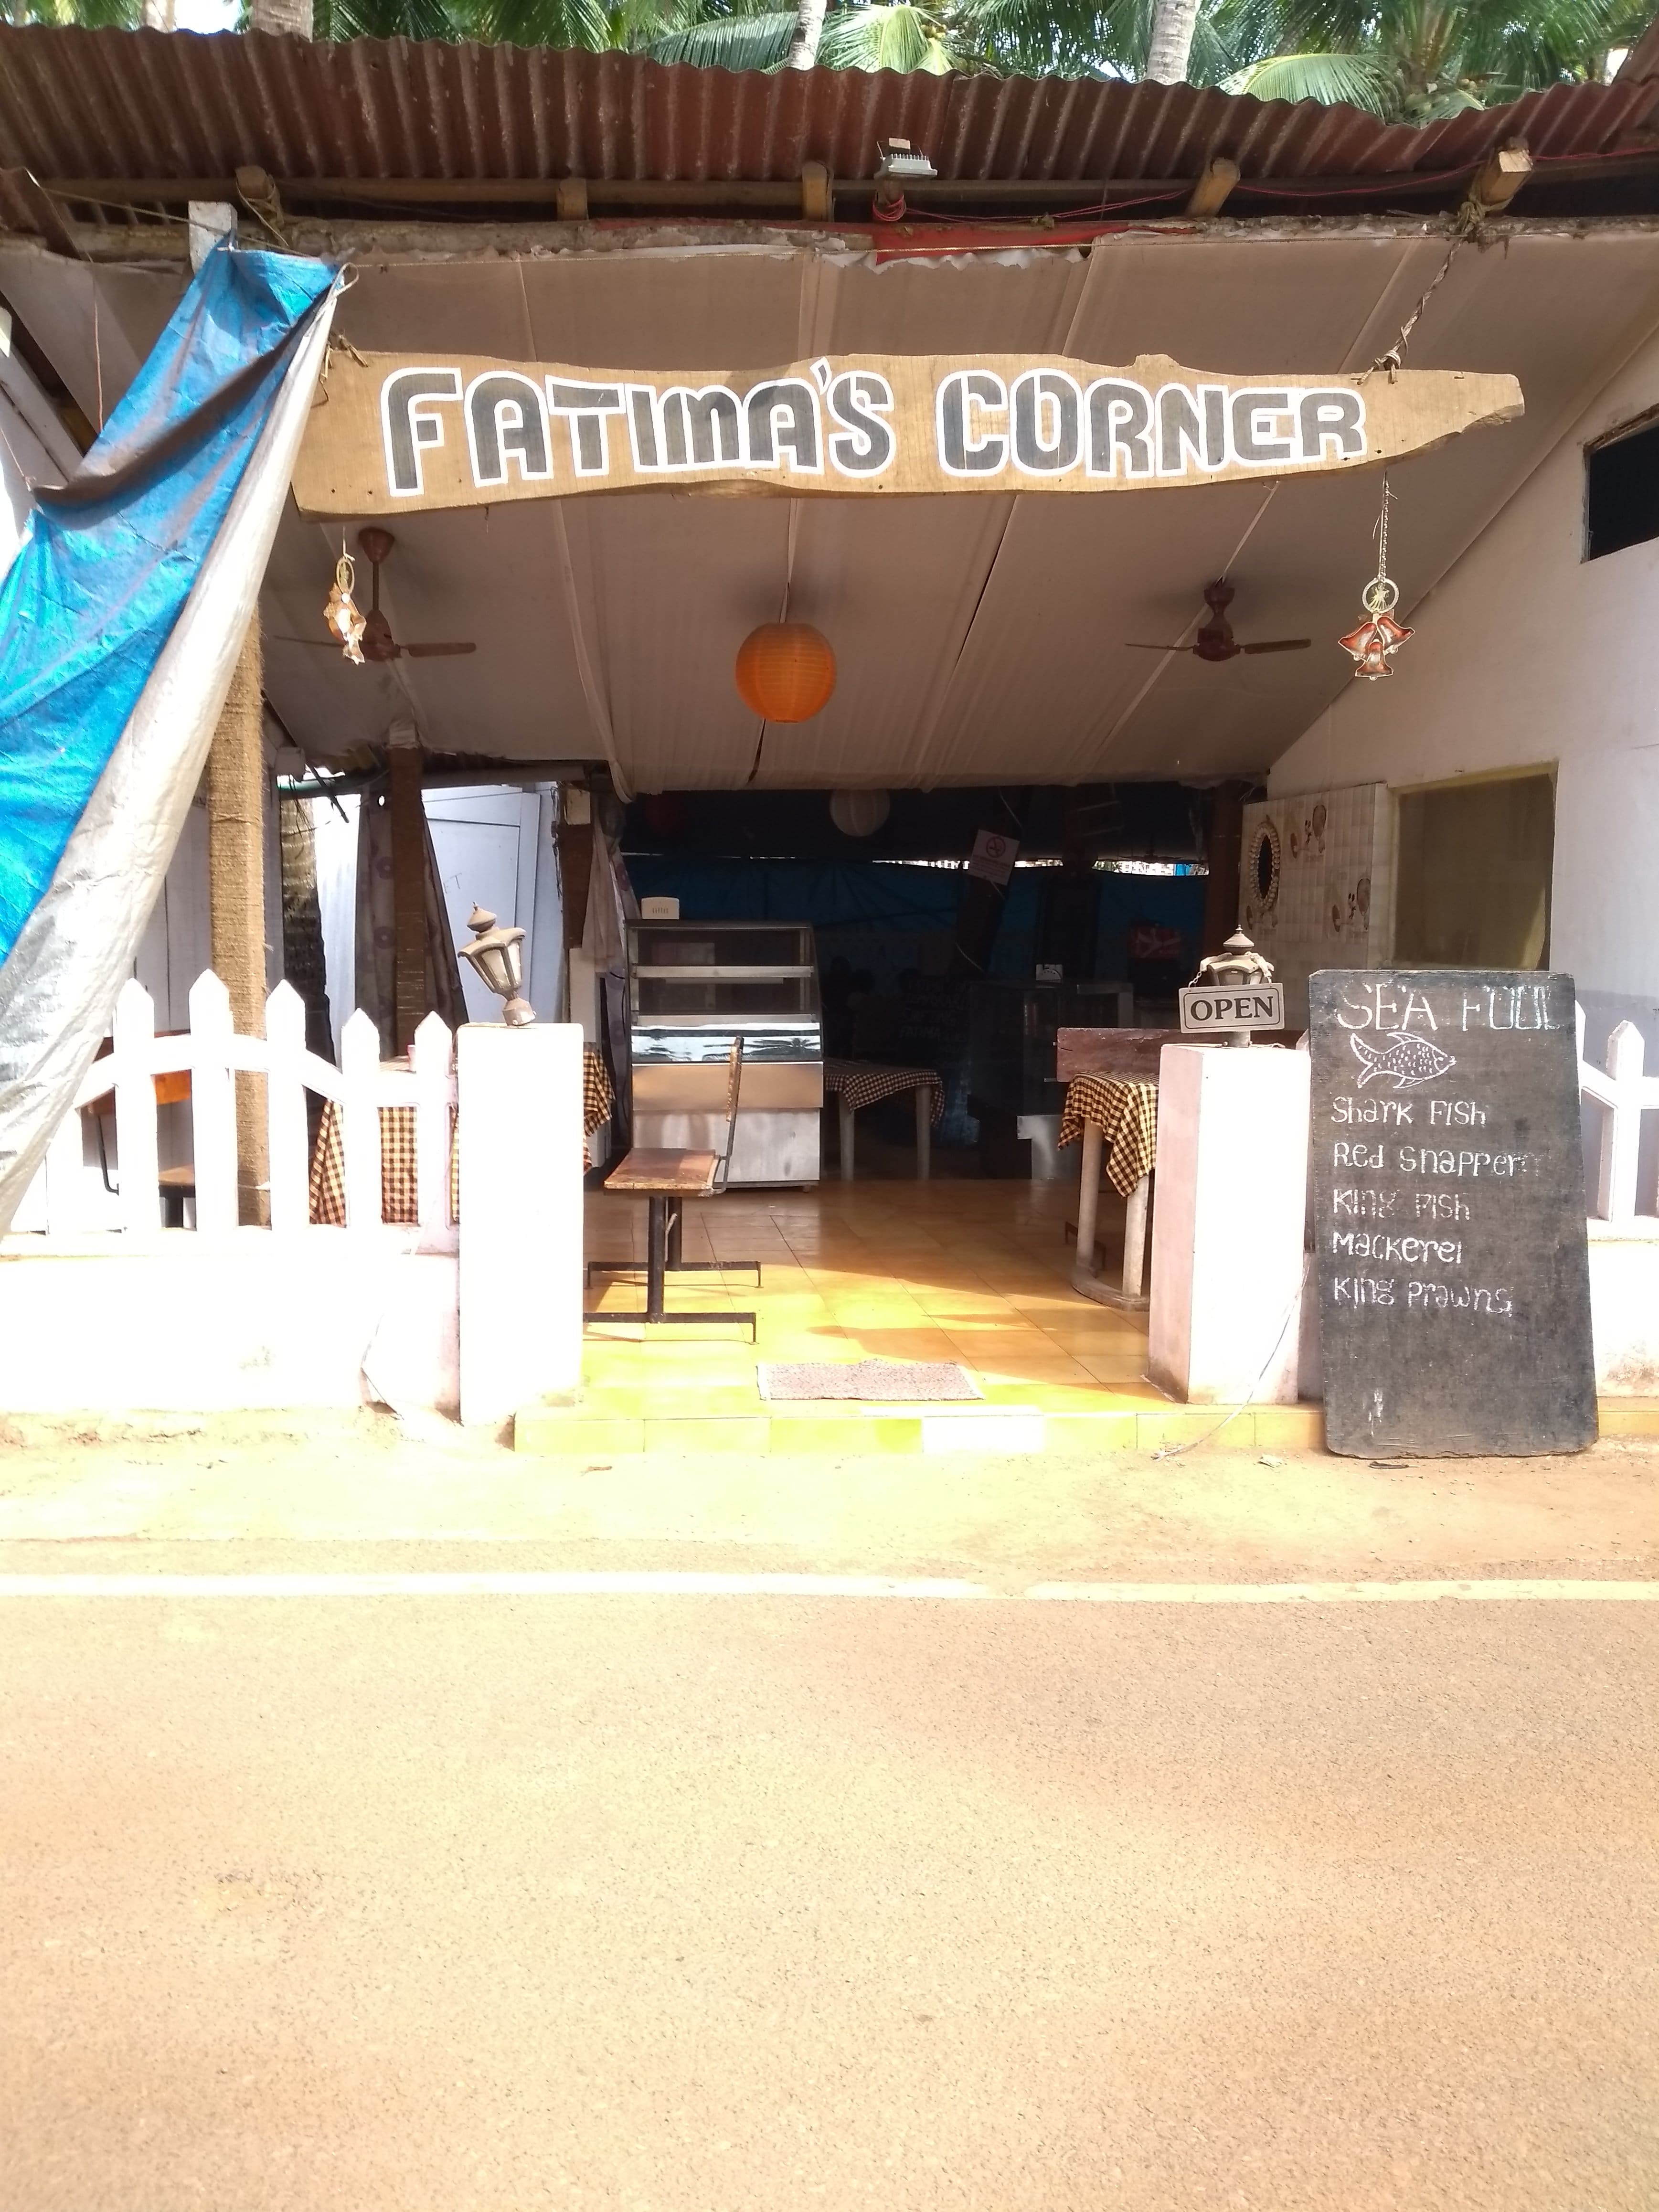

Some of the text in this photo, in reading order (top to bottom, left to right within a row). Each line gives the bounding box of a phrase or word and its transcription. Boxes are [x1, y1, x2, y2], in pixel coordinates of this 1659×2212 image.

[381, 356, 1369, 497] FATIMA'S CORNER
[1191, 996, 1273, 1021] OPEN
[1335, 982, 1438, 1032] SEA
[1333, 1142, 1384, 1168] Red
